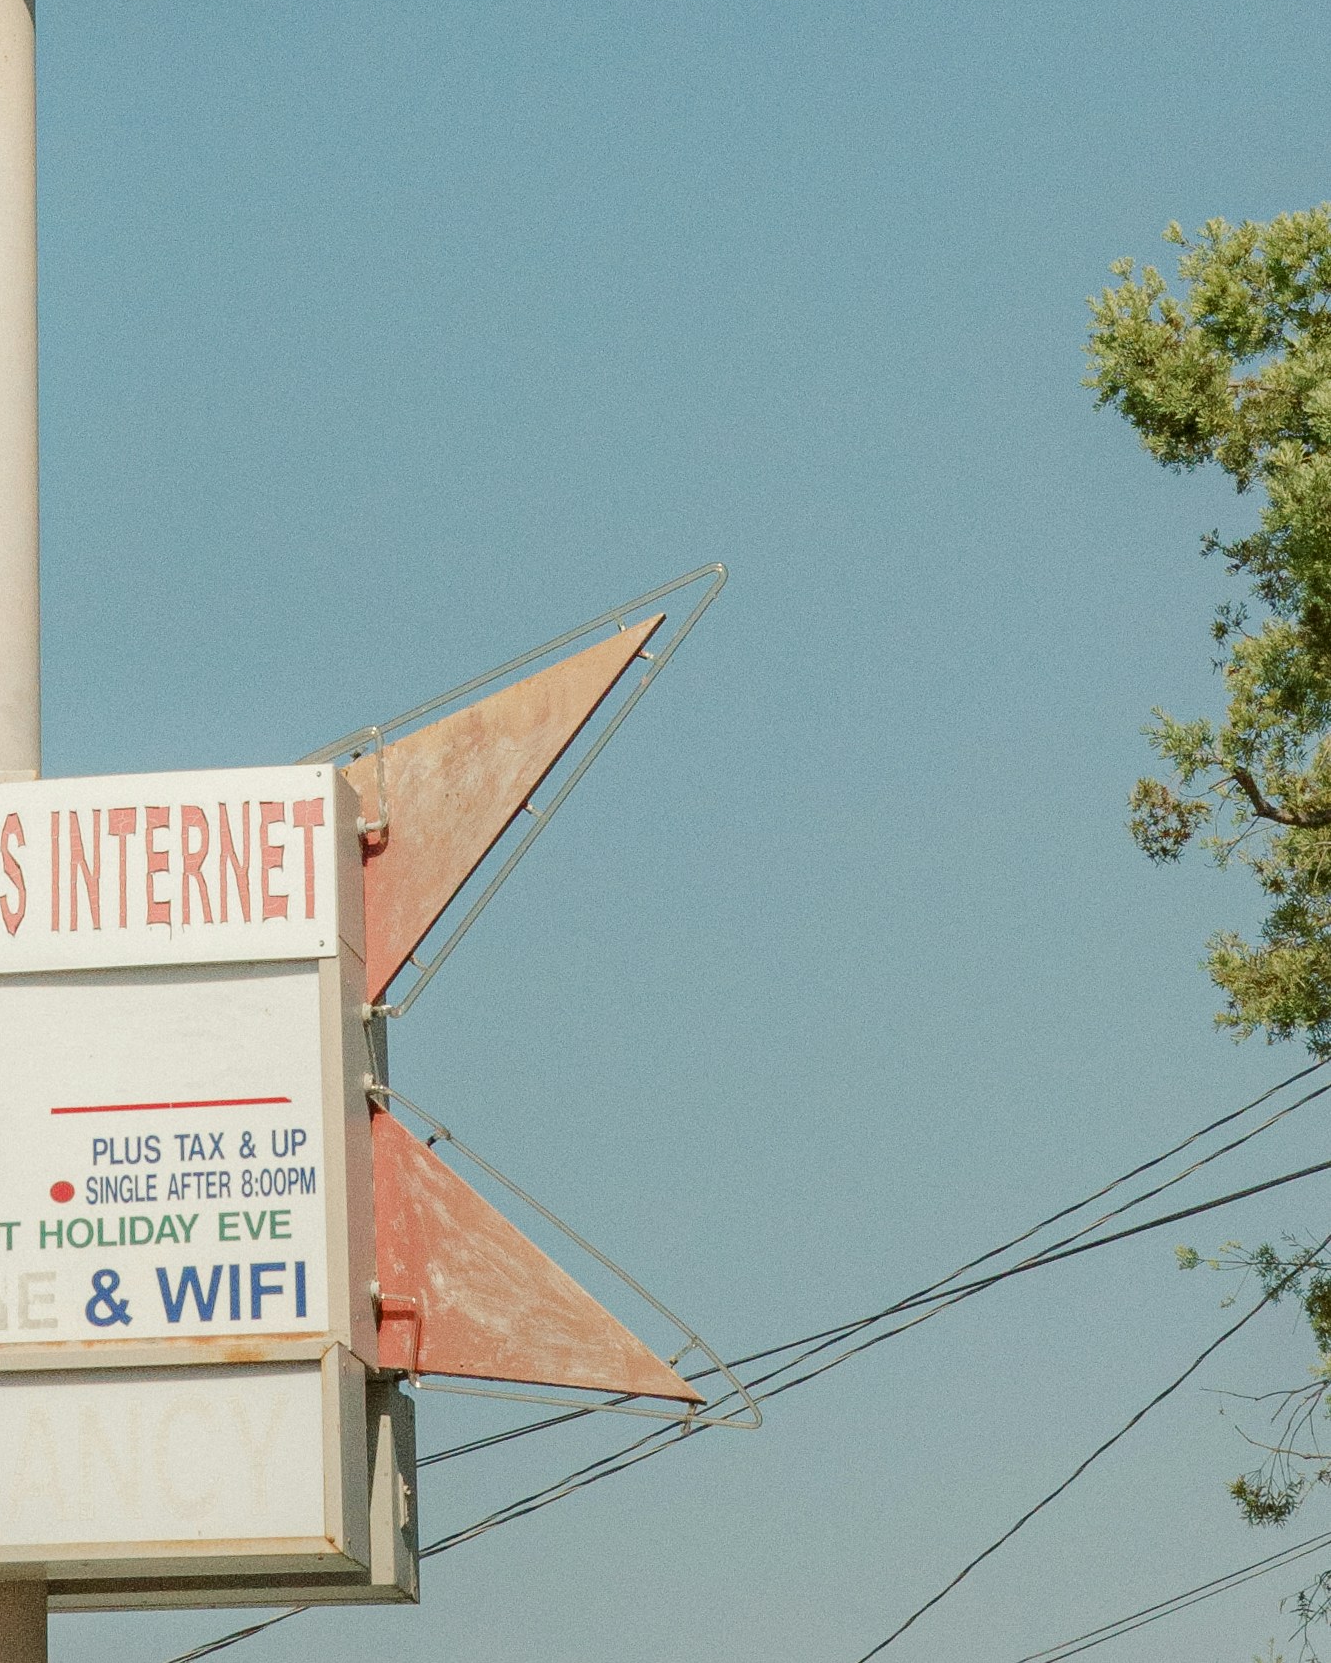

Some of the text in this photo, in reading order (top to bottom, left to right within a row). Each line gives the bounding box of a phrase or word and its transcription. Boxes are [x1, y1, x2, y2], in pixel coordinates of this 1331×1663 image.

[51, 798, 326, 933] INTERNET
[92, 1129, 307, 1166] PLUS TAX & UP
[86, 1167, 316, 1204] SINGLE AFTER 8:00PM
[39, 1214, 199, 1250] HOLIDAY
[218, 1209, 292, 1241] EVE
[84, 1269, 132, 1326] &
[156, 1261, 308, 1324] WIFI
